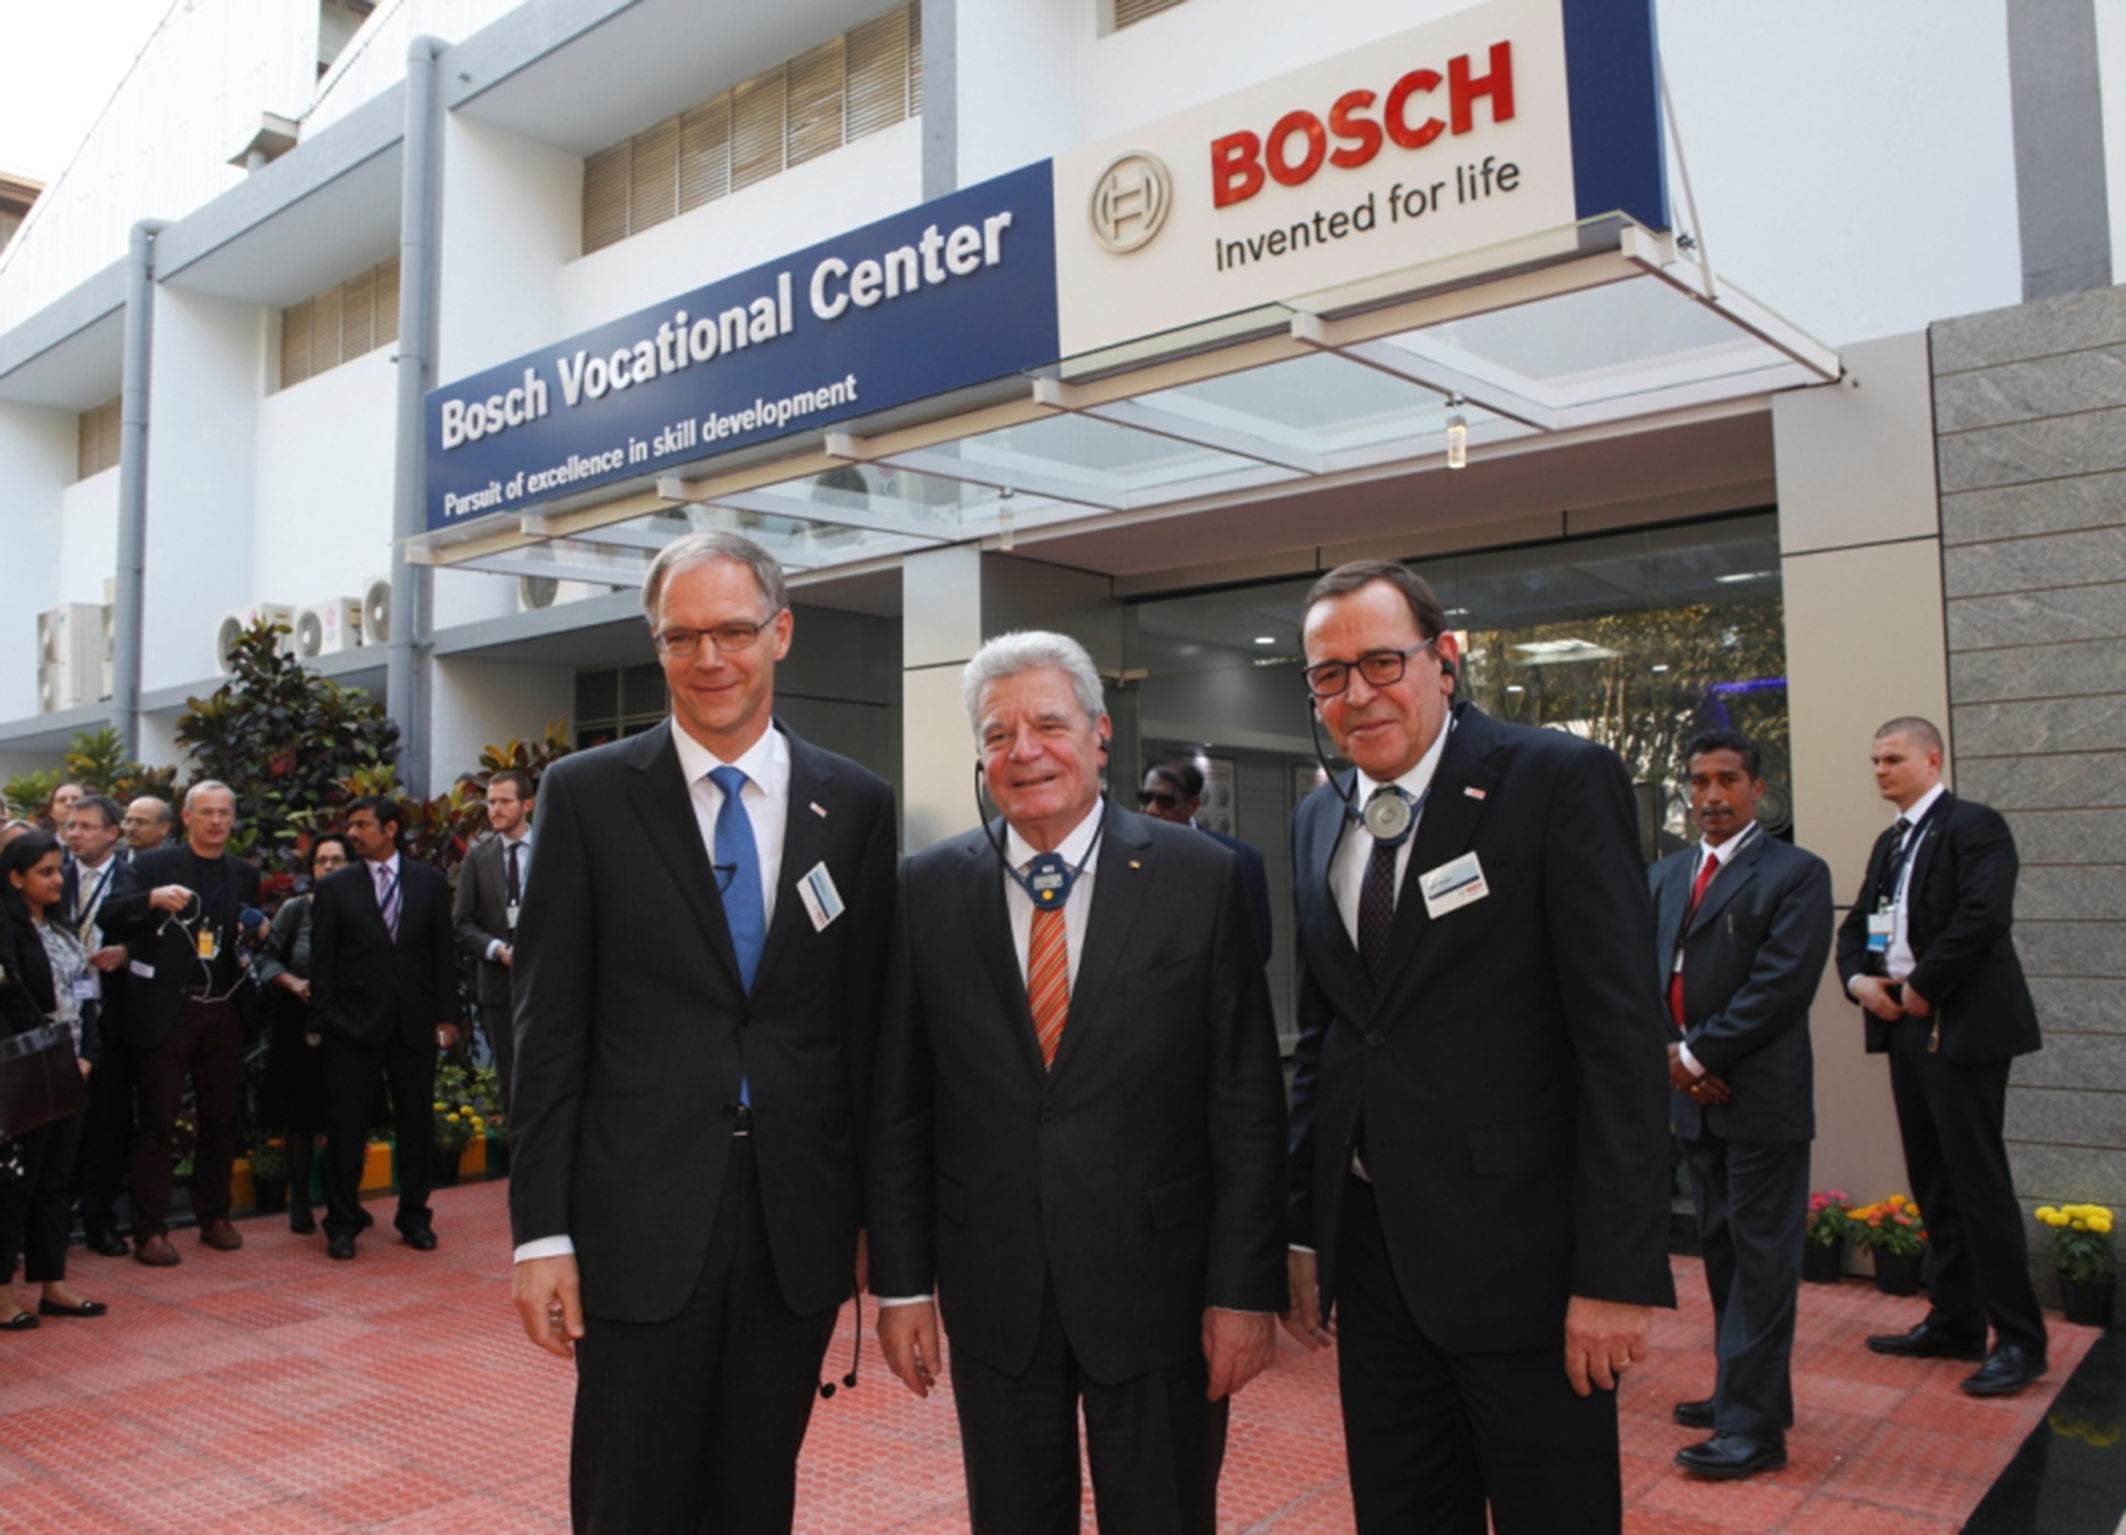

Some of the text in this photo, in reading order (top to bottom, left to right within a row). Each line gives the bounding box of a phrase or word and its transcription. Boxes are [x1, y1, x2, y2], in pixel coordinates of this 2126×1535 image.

[1211, 41, 1515, 208] BOSCH
[1216, 155, 1520, 271] Invented for life
[441, 210, 1013, 450] Bosch Vocational Center
[443, 373, 858, 518] Pursuit of excellence in skill development
